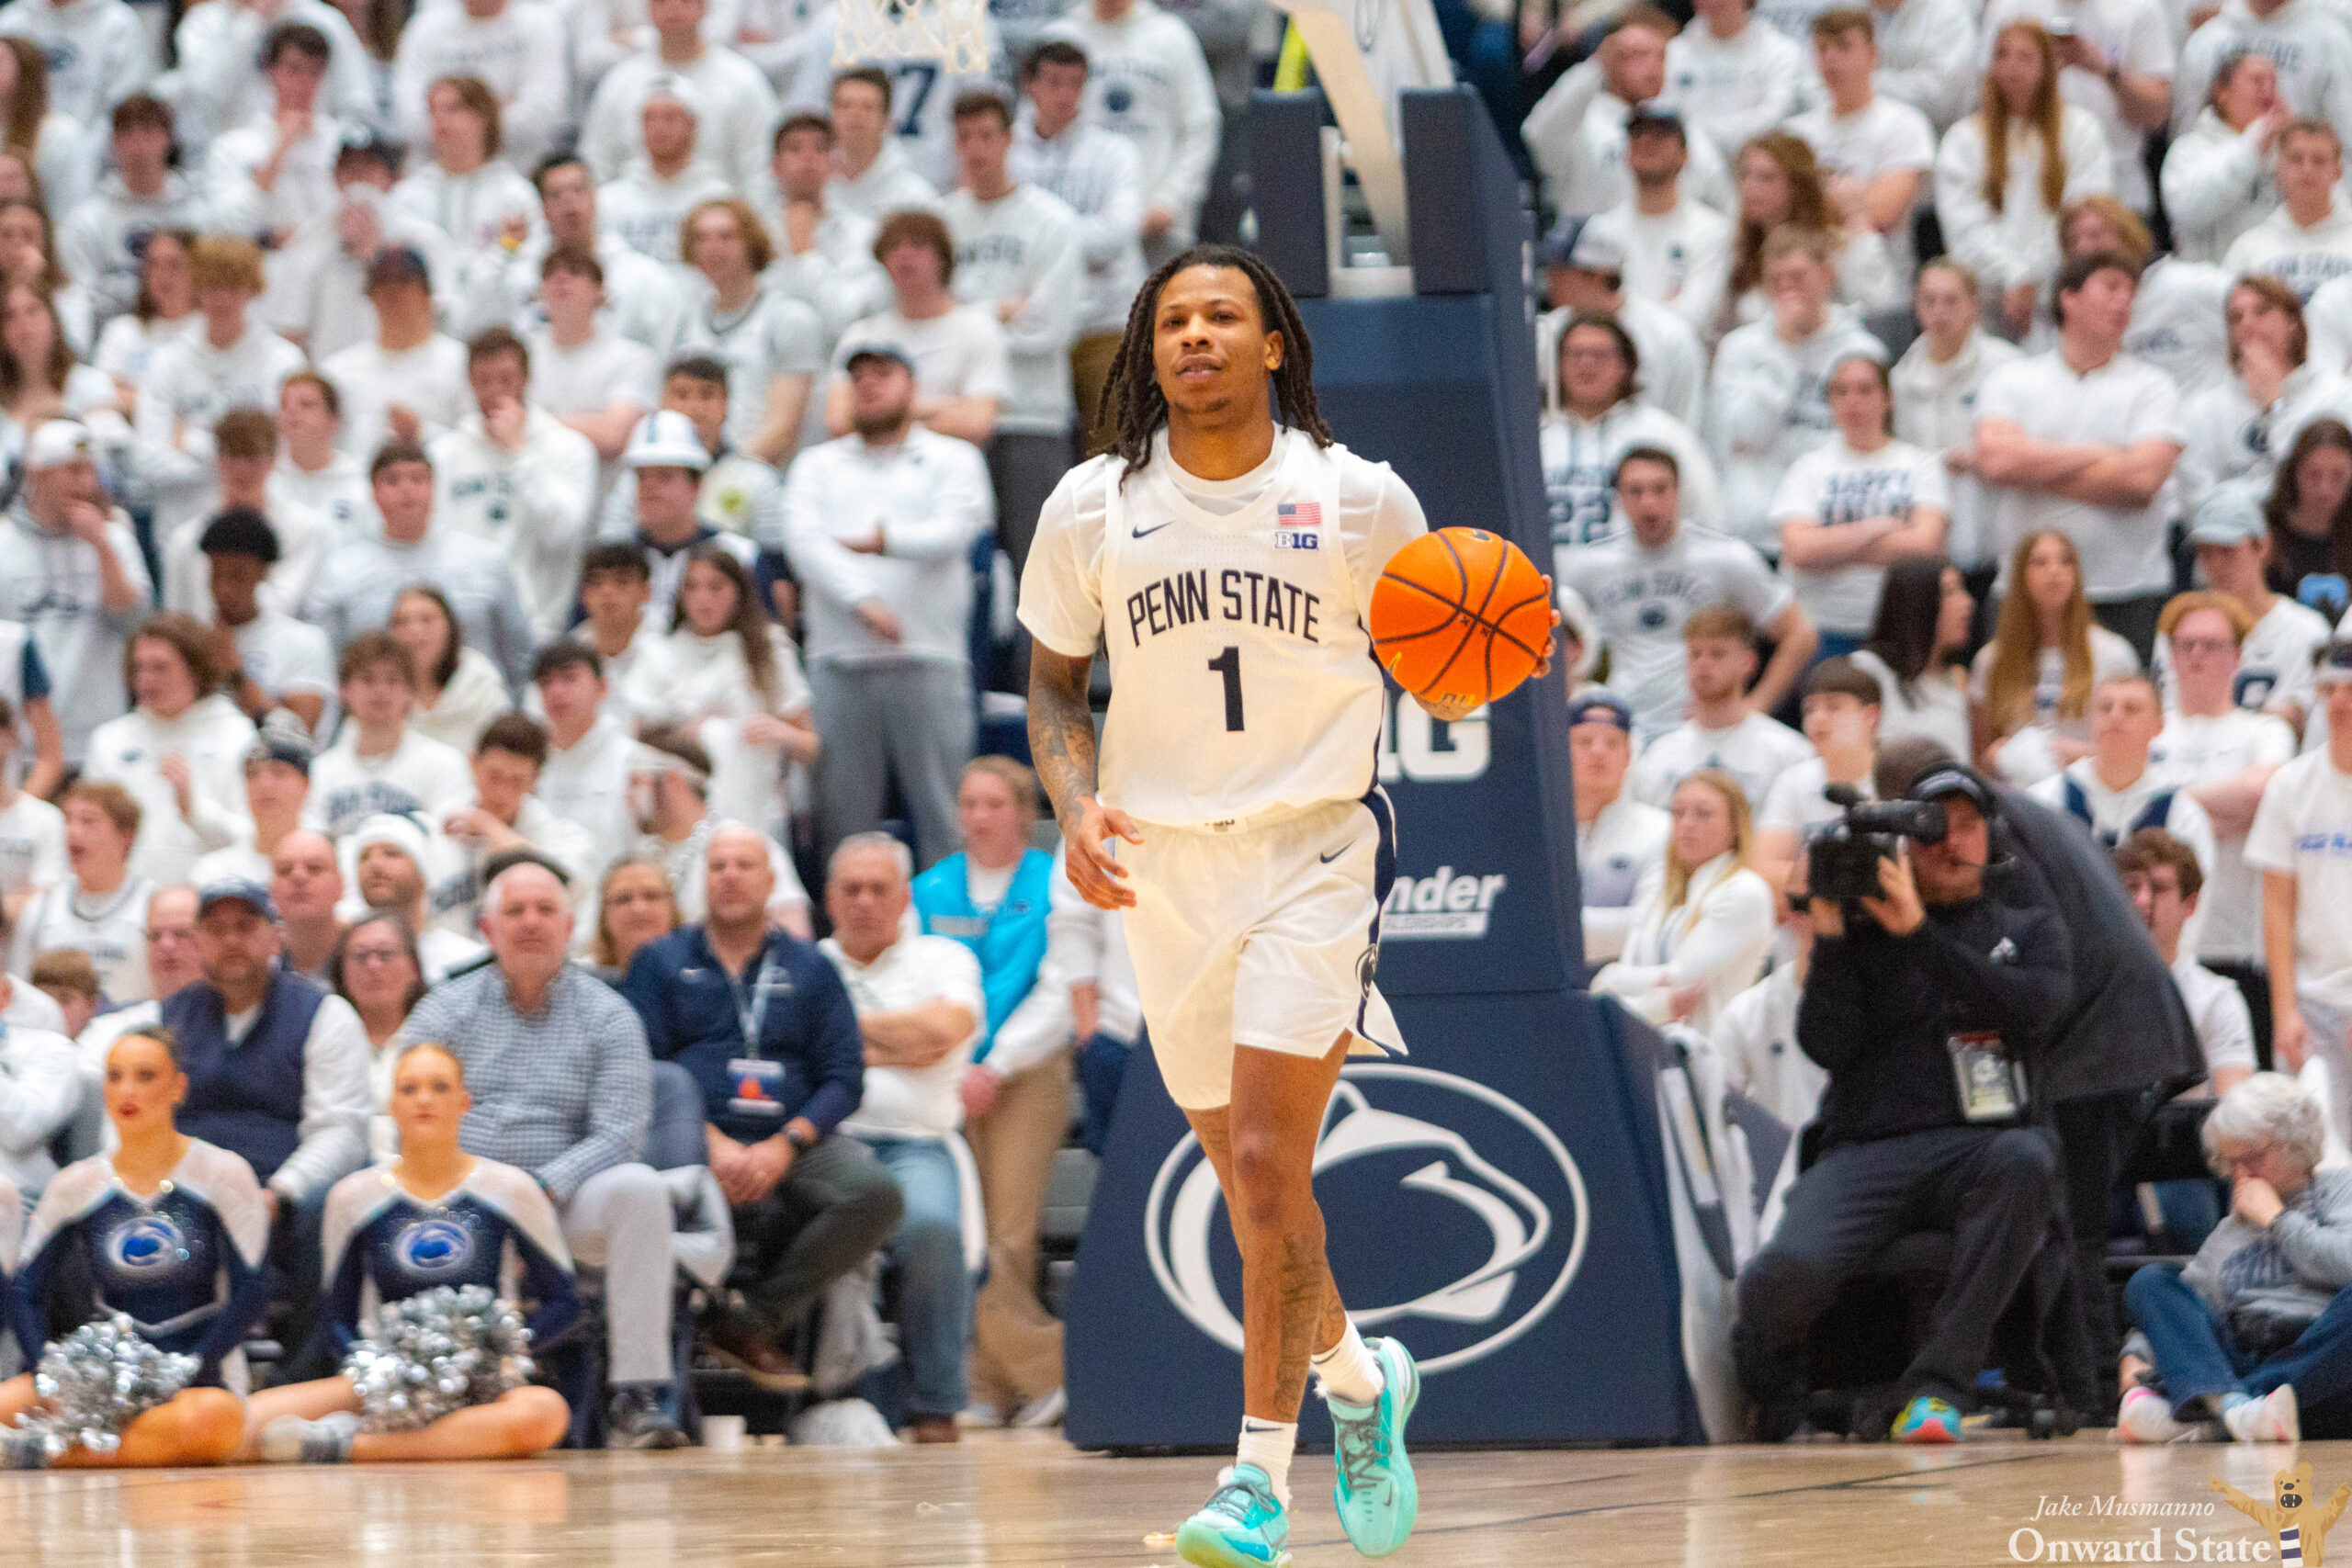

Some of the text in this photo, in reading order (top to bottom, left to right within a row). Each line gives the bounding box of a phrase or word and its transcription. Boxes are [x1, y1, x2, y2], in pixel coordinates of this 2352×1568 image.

[1127, 569, 1320, 648] PENN STATE
[1207, 646, 1245, 732] 1
